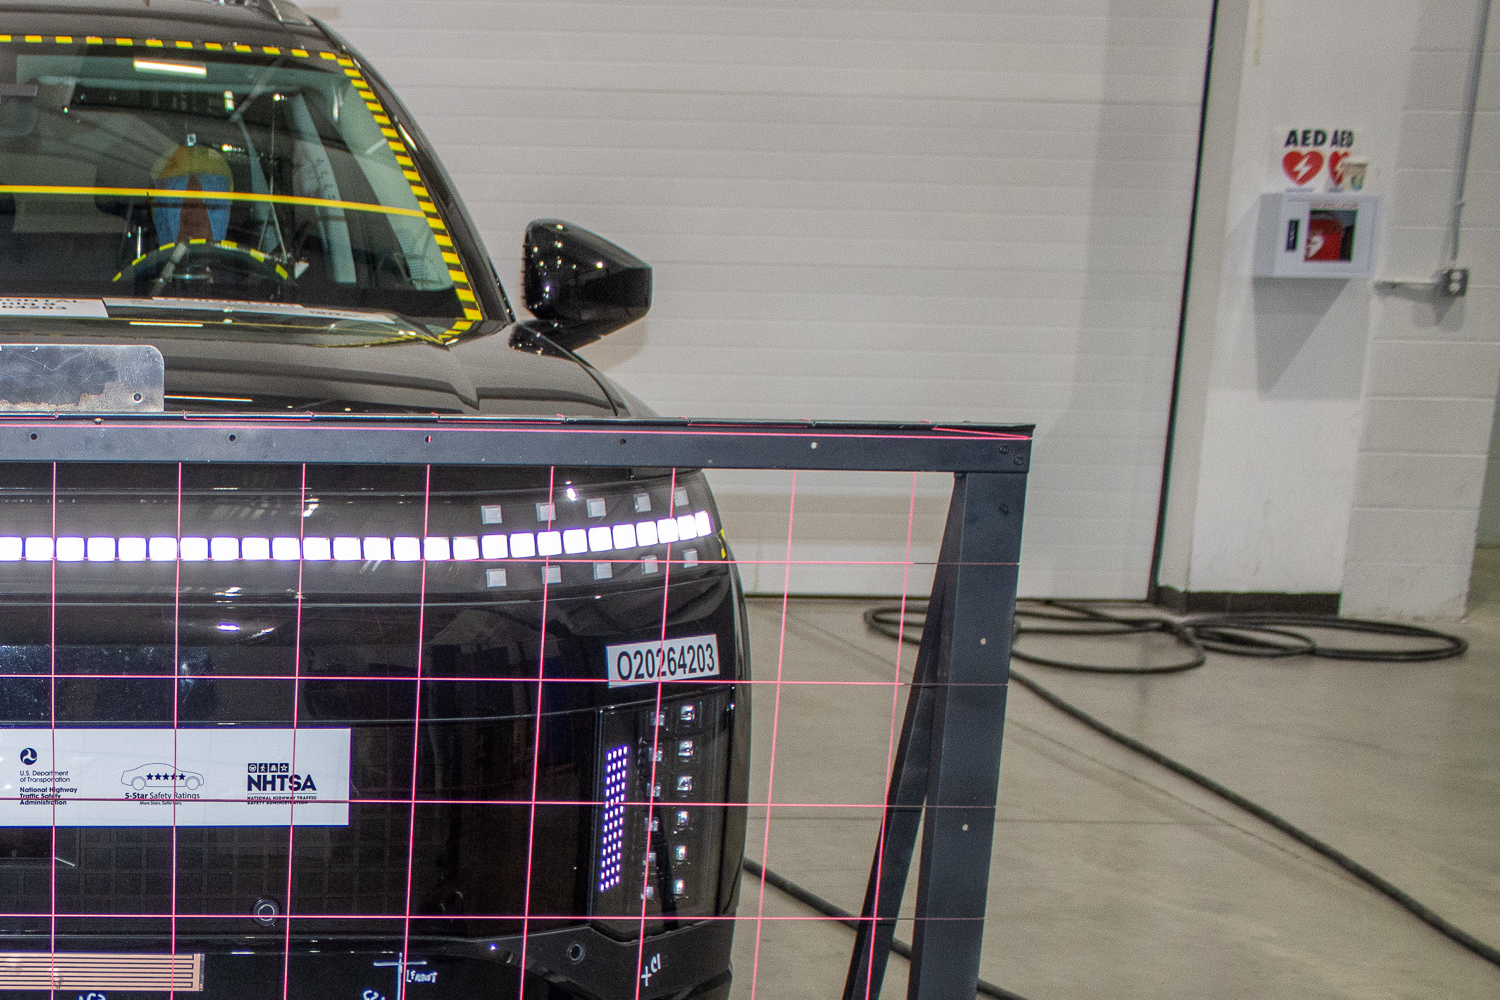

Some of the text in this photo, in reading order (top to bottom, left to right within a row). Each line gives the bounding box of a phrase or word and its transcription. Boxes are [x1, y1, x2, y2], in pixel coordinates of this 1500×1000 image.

[1284, 129, 1328, 147] AED
[617, 643, 715, 681] O20264203
[247, 774, 317, 791] NHTSA
[149, 791, 172, 800] Safety
